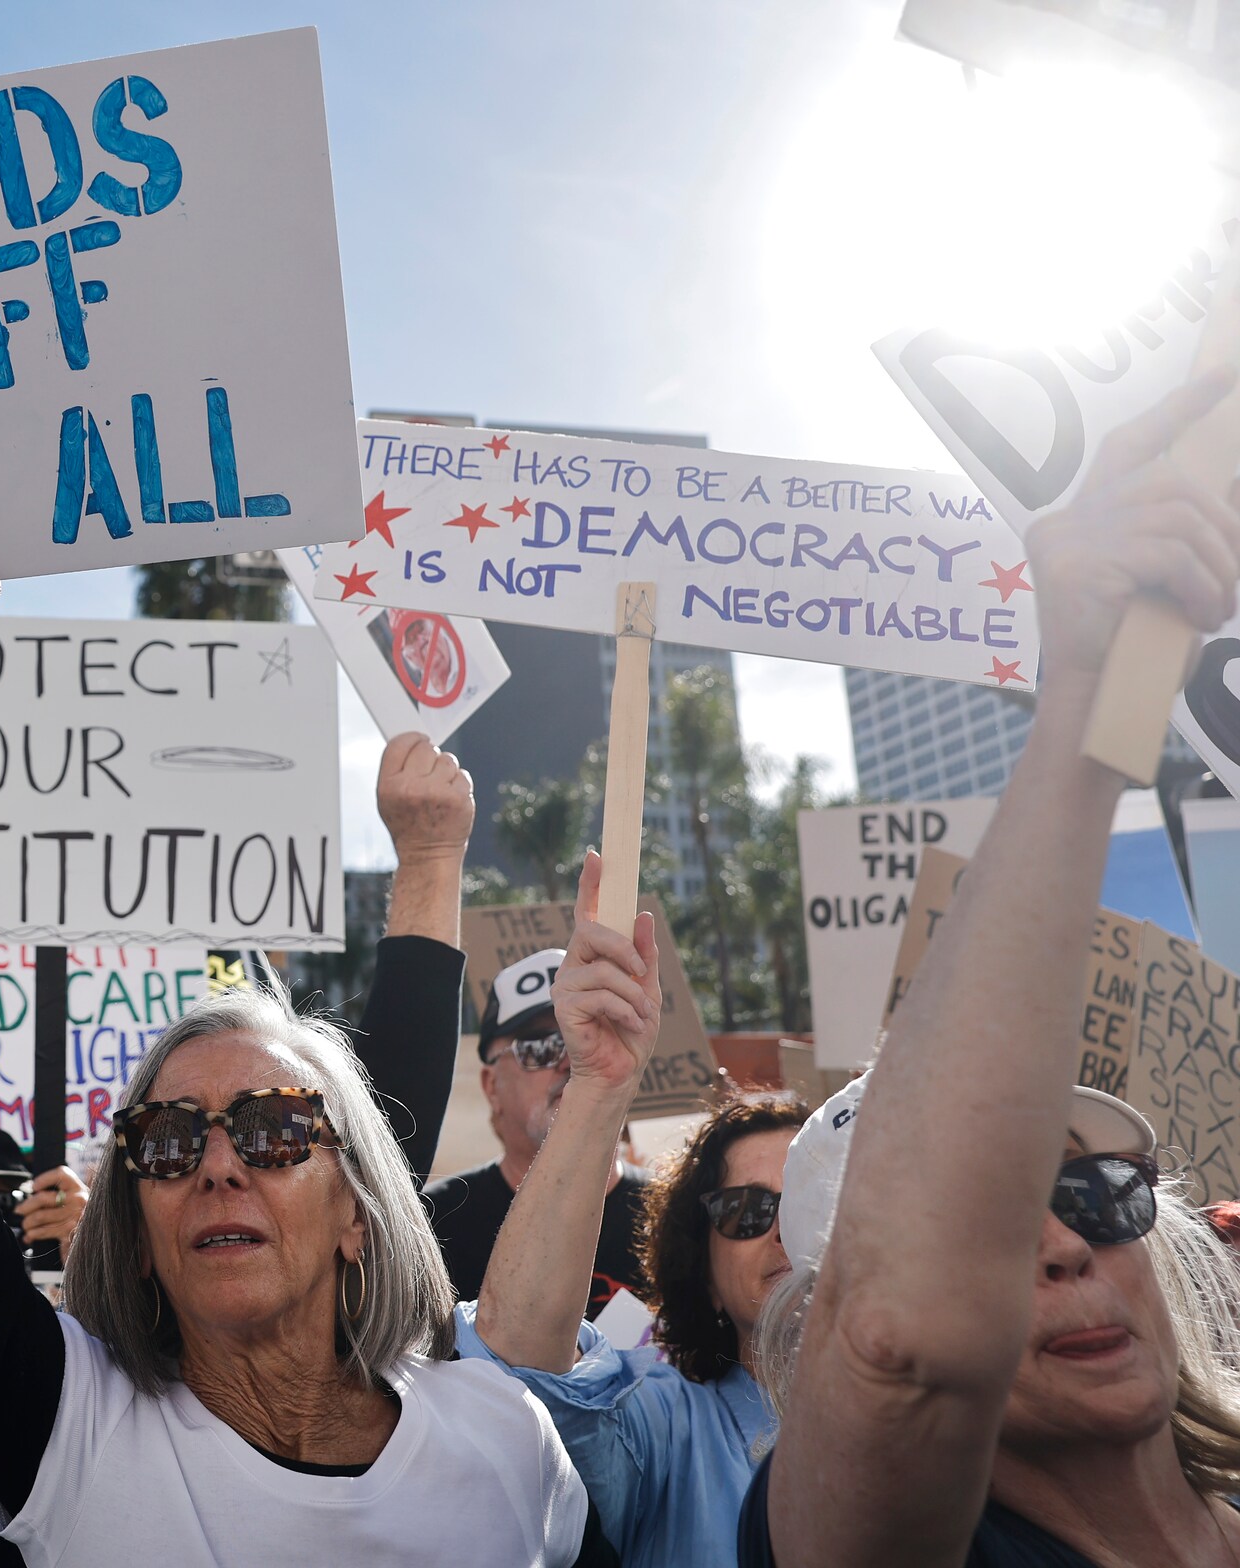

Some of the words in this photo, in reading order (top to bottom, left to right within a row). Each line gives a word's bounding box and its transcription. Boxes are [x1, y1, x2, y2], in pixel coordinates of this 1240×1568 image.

[52, 386, 291, 544] ALL
[361, 434, 485, 481] THERE
[513, 450, 591, 489] HAS
[601, 458, 651, 496] TO
[676, 467, 728, 502] BE
[741, 475, 770, 505] A
[782, 476, 911, 516] BETTER
[929, 491, 993, 522] WA
[521, 502, 981, 583] DEMOCRACY
[404, 550, 447, 583] IS
[479, 557, 581, 599] NOT
[681, 585, 1018, 648] NEGOTIABLE
[860, 809, 947, 845] END
[863, 853, 915, 880] TH
[482, 907, 552, 938] THE
[810, 894, 909, 930] OLIGA
[1147, 961, 1240, 1042] CAL
[639, 1051, 713, 1094] IRES
